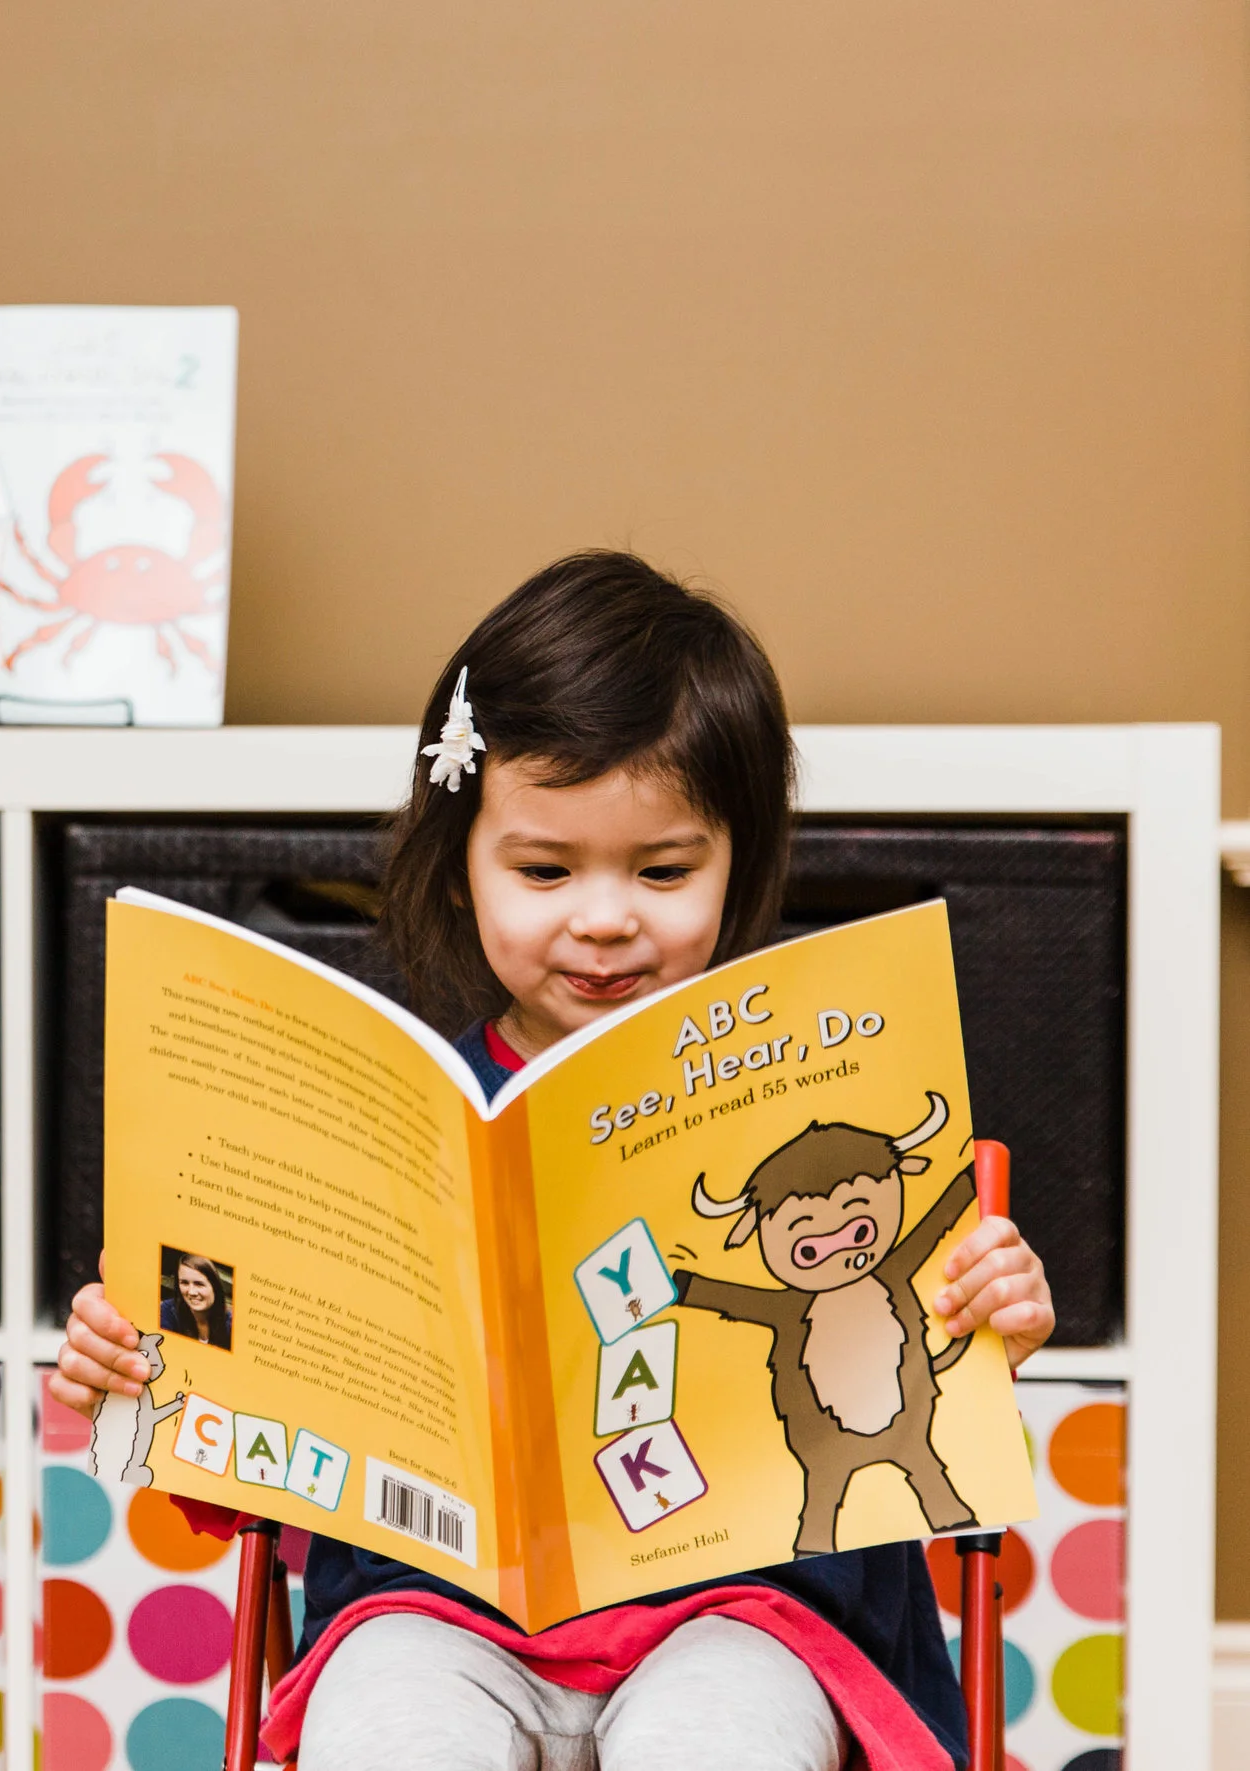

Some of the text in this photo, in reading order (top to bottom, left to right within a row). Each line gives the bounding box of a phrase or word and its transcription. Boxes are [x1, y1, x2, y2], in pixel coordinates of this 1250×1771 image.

[174, 353, 200, 390] 2
[672, 984, 772, 1058] ABC
[590, 1009, 885, 1145] See, Hear, Do
[619, 1060, 860, 1162] Learn to read 55 words
[199, 1154, 435, 1266] Use hand motions to help remember the sounds
[218, 1137, 419, 1234] Teach your child the sounds letters make
[189, 1196, 443, 1313] Blend sounds together to read 55 three-letter words
[190, 1174, 224, 1192] Learn
[226, 1186, 244, 1199] the
[246, 1195, 283, 1212] sounds
[284, 1209, 295, 1219] in
[297, 1215, 333, 1233] groups
[335, 1230, 346, 1239] of
[347, 1233, 367, 1248] four
[369, 1244, 401, 1266] letters
[402, 1264, 412, 1273] at
[421, 1274, 442, 1292] time
[596, 1246, 633, 1297] Y
[249, 1273, 287, 1291] Stefanie
[346, 1310, 363, 1322] has
[365, 1318, 385, 1332] been
[387, 1330, 422, 1353] teaching
[424, 1350, 456, 1372] children
[249, 1290, 259, 1298] to
[260, 1295, 281, 1306] read
[282, 1301, 295, 1311] for
[324, 1316, 362, 1338] Through
[364, 1334, 379, 1344] her
[380, 1343, 423, 1367] experience
[423, 1365, 456, 1389] teaching
[248, 1340, 278, 1353] simple
[281, 1349, 346, 1379] Learn-to-Read
[348, 1377, 379, 1392] picture
[408, 1401, 425, 1414] She
[428, 1412, 446, 1426] lives
[448, 1425, 458, 1434] in
[254, 1356, 301, 1378] Pittsburgh
[302, 1376, 323, 1387] with
[324, 1381, 340, 1392] her
[342, 1388, 380, 1409] husband
[381, 1407, 399, 1418] and
[400, 1413, 416, 1424] five
[271, 1330, 294, 1343] local
[342, 1356, 379, 1376] Stefanie
[381, 1373, 397, 1385] has
[399, 1383, 440, 1408] developed
[442, 1406, 458, 1418] this
[364, 1352, 382, 1363] and
[384, 1360, 419, 1382] running
[421, 1380, 457, 1403] storytime
[611, 1349, 659, 1400] A
[194, 1413, 333, 1478] C A T
[389, 1450, 409, 1464] Best
[410, 1460, 423, 1470] for
[424, 1468, 443, 1481] ages
[444, 1476, 458, 1489] 2-6
[619, 1437, 671, 1493] K
[630, 1529, 730, 1567] Stefanie Hohl
